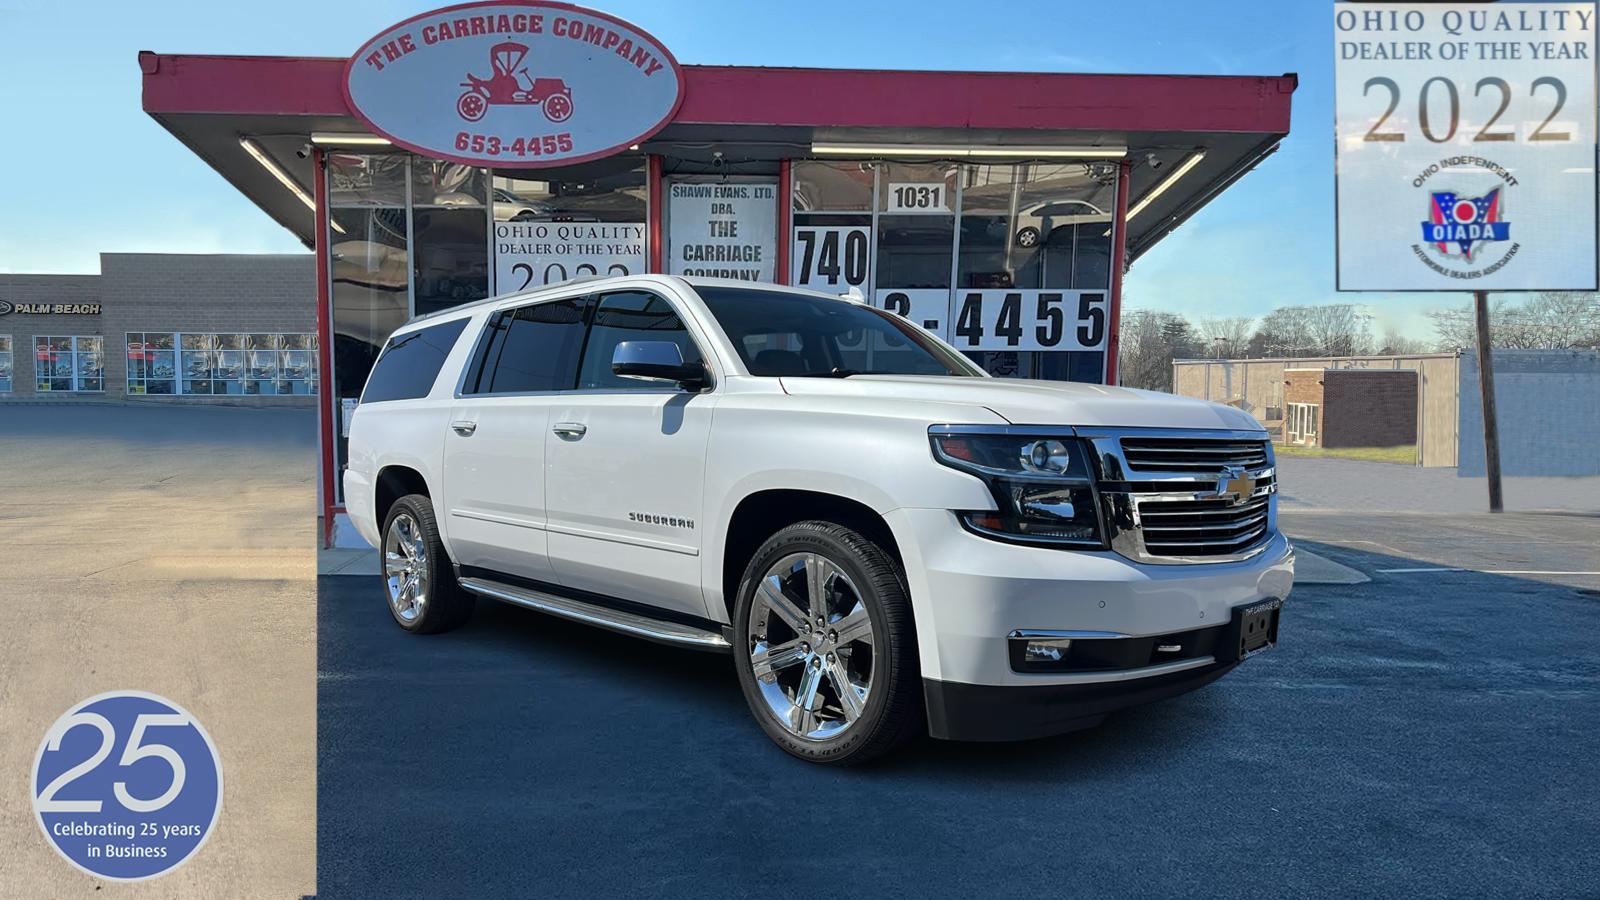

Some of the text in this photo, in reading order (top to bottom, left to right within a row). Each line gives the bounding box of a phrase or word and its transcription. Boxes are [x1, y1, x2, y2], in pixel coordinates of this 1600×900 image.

[1336, 10, 1592, 36] OHIO QUALITY
[365, 14, 664, 77] THE CARRIAGE COMPANY
[1340, 41, 1589, 60] DEALER OF THE YEAR
[1363, 76, 1571, 143] 2022
[454, 131, 573, 156] 653-4455
[1412, 155, 1519, 188] OHIO INDEPENDENT
[672, 185, 712, 198] SHAWN
[754, 187, 774, 199] LTD.
[894, 187, 940, 208] 1031
[711, 203, 736, 215] DBA.
[497, 225, 645, 241] OHIO QUALITY
[708, 220, 738, 238] THE
[1432, 224, 1495, 241] OIADA
[499, 243, 641, 255] DEALER OF THE YEAR
[683, 244, 762, 262] CARRIAGE
[797, 229, 868, 285] 740
[14, 303, 100, 315] PALM BEACH
[628, 511, 695, 529] SUBURBAN
